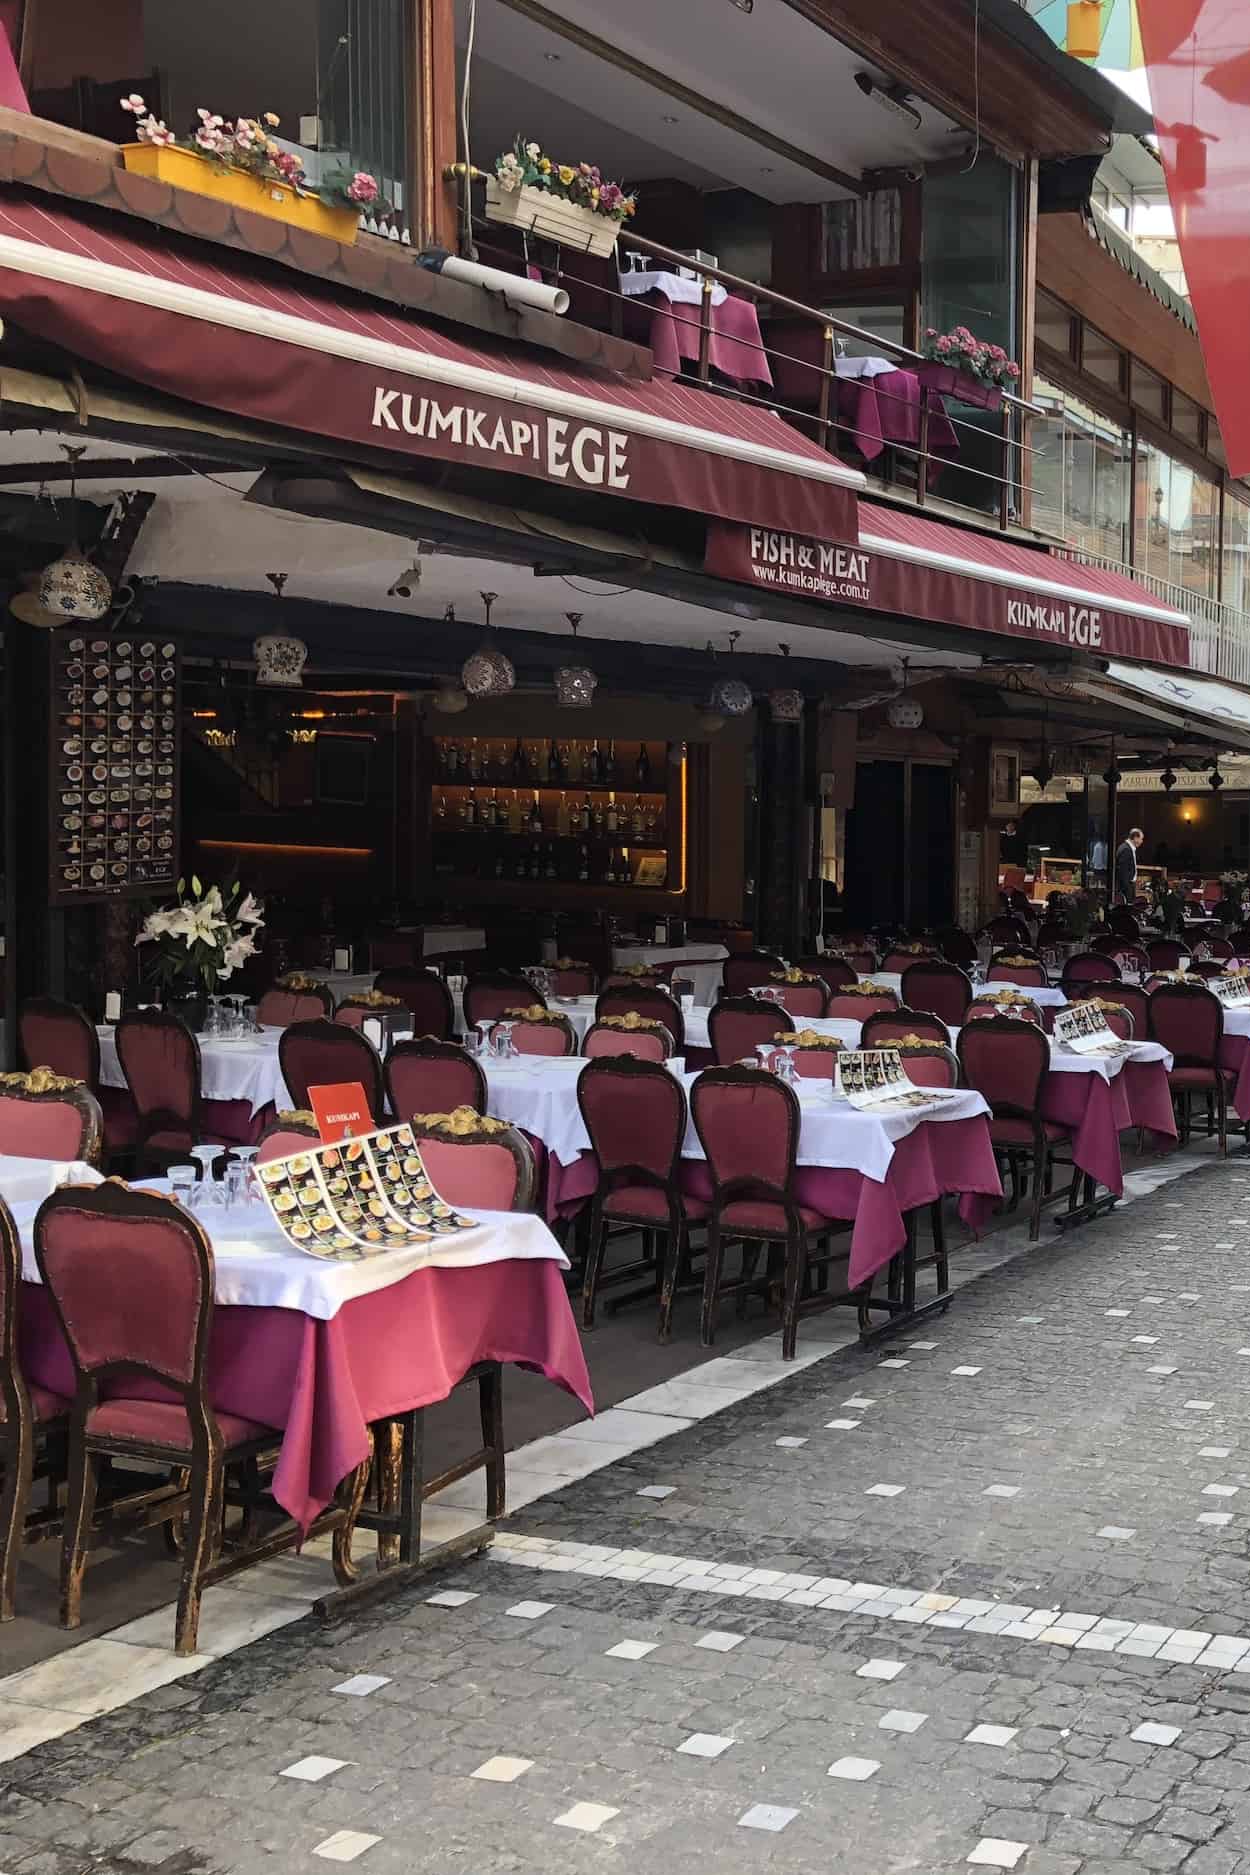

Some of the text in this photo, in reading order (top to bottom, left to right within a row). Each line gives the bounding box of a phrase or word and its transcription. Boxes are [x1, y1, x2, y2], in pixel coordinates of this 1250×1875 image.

[546, 416, 631, 489] EGE
[750, 527, 870, 583] FISH & MEAT
[1068, 605, 1102, 647] EGE
